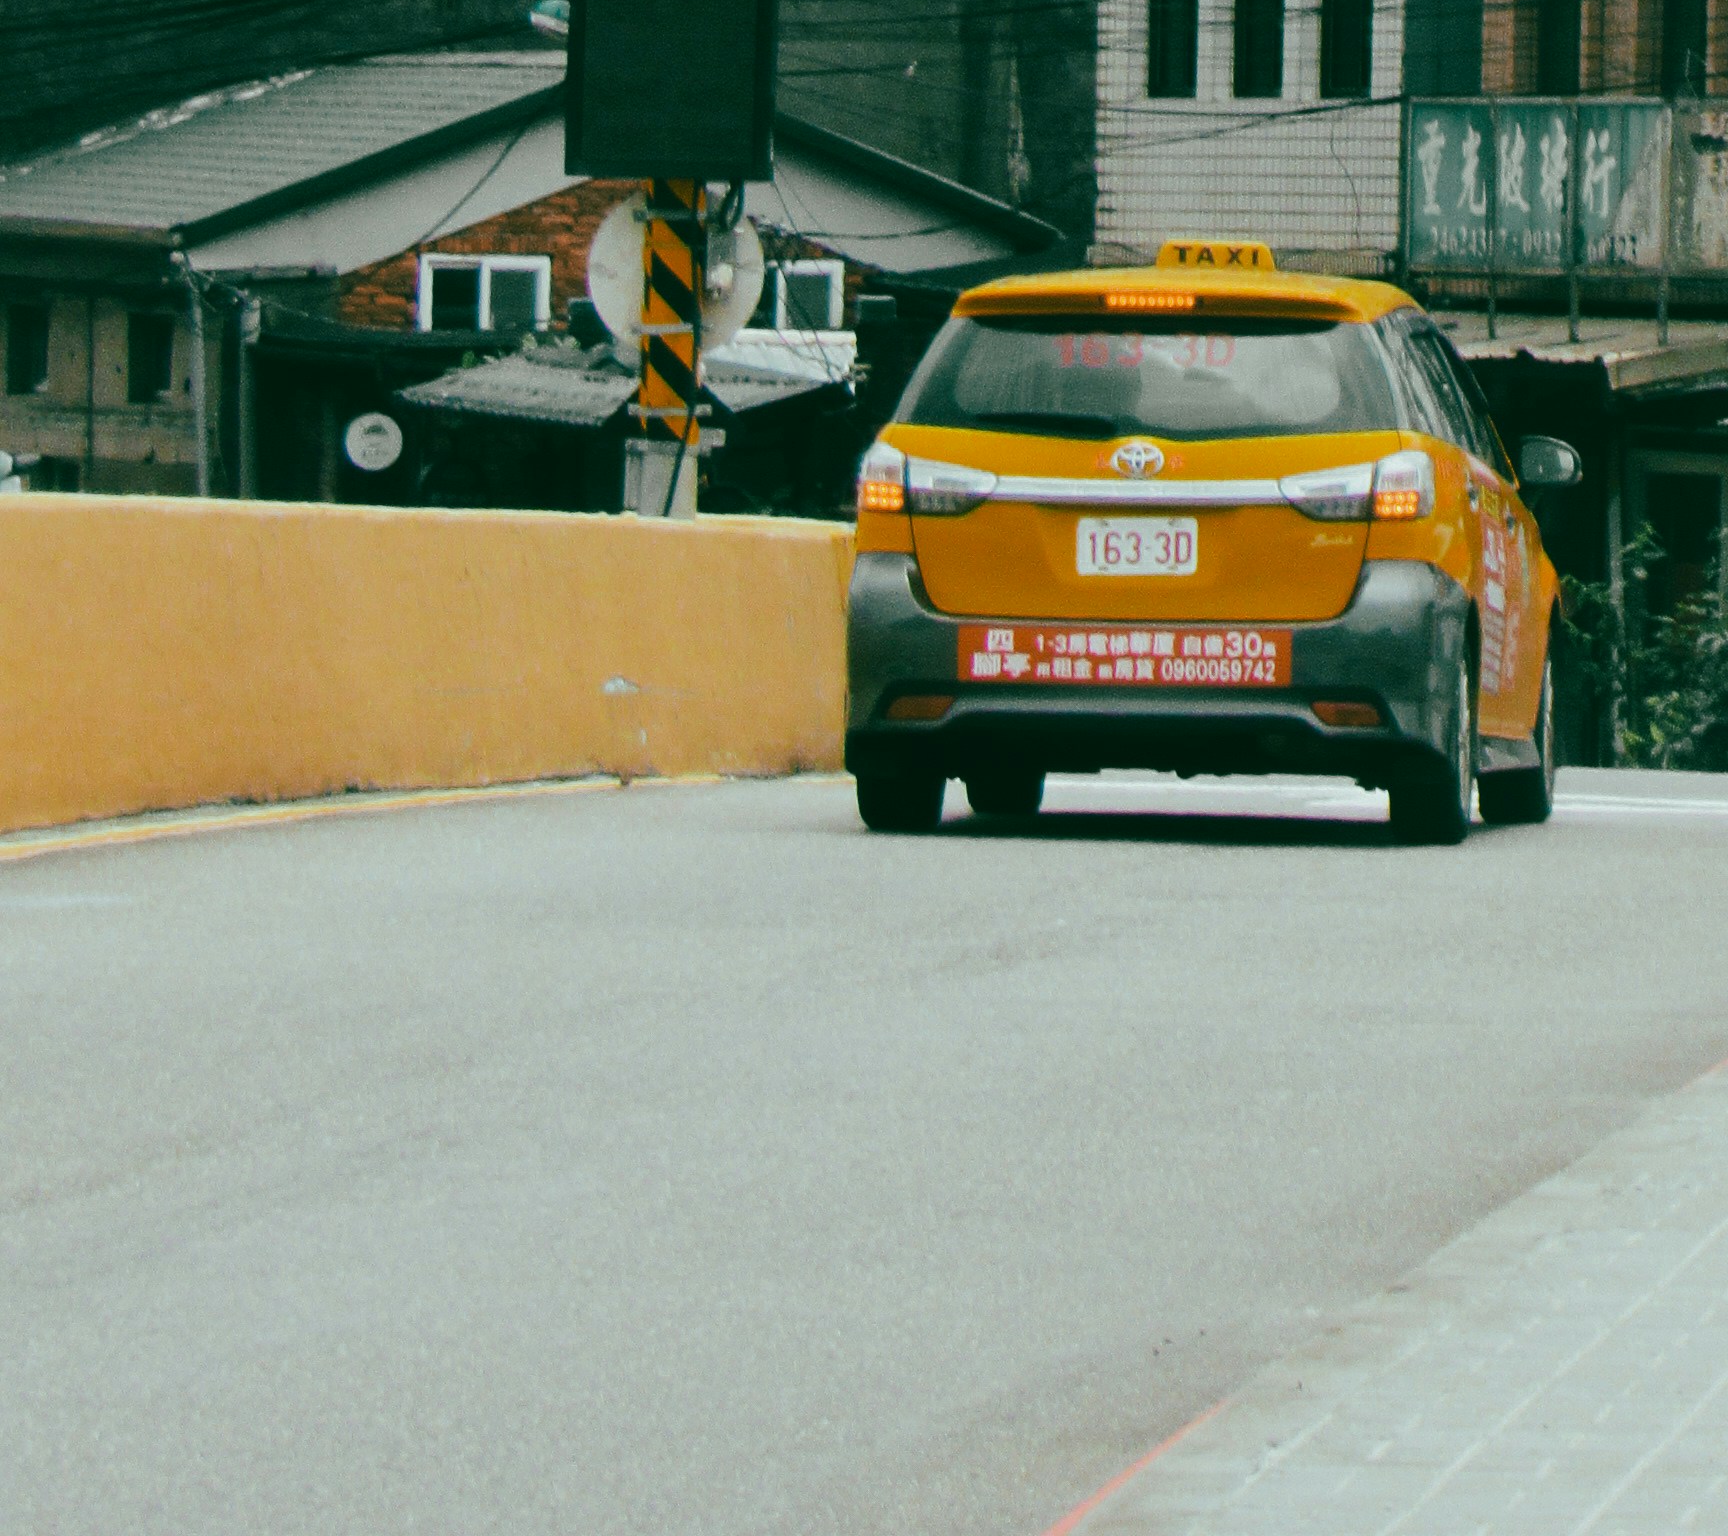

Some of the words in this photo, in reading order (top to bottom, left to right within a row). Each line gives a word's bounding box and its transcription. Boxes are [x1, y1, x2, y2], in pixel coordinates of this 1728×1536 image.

[1172, 244, 1261, 266] TAXI
[1053, 332, 1237, 369] 163-3D
[1088, 530, 1193, 566] 163-3D
